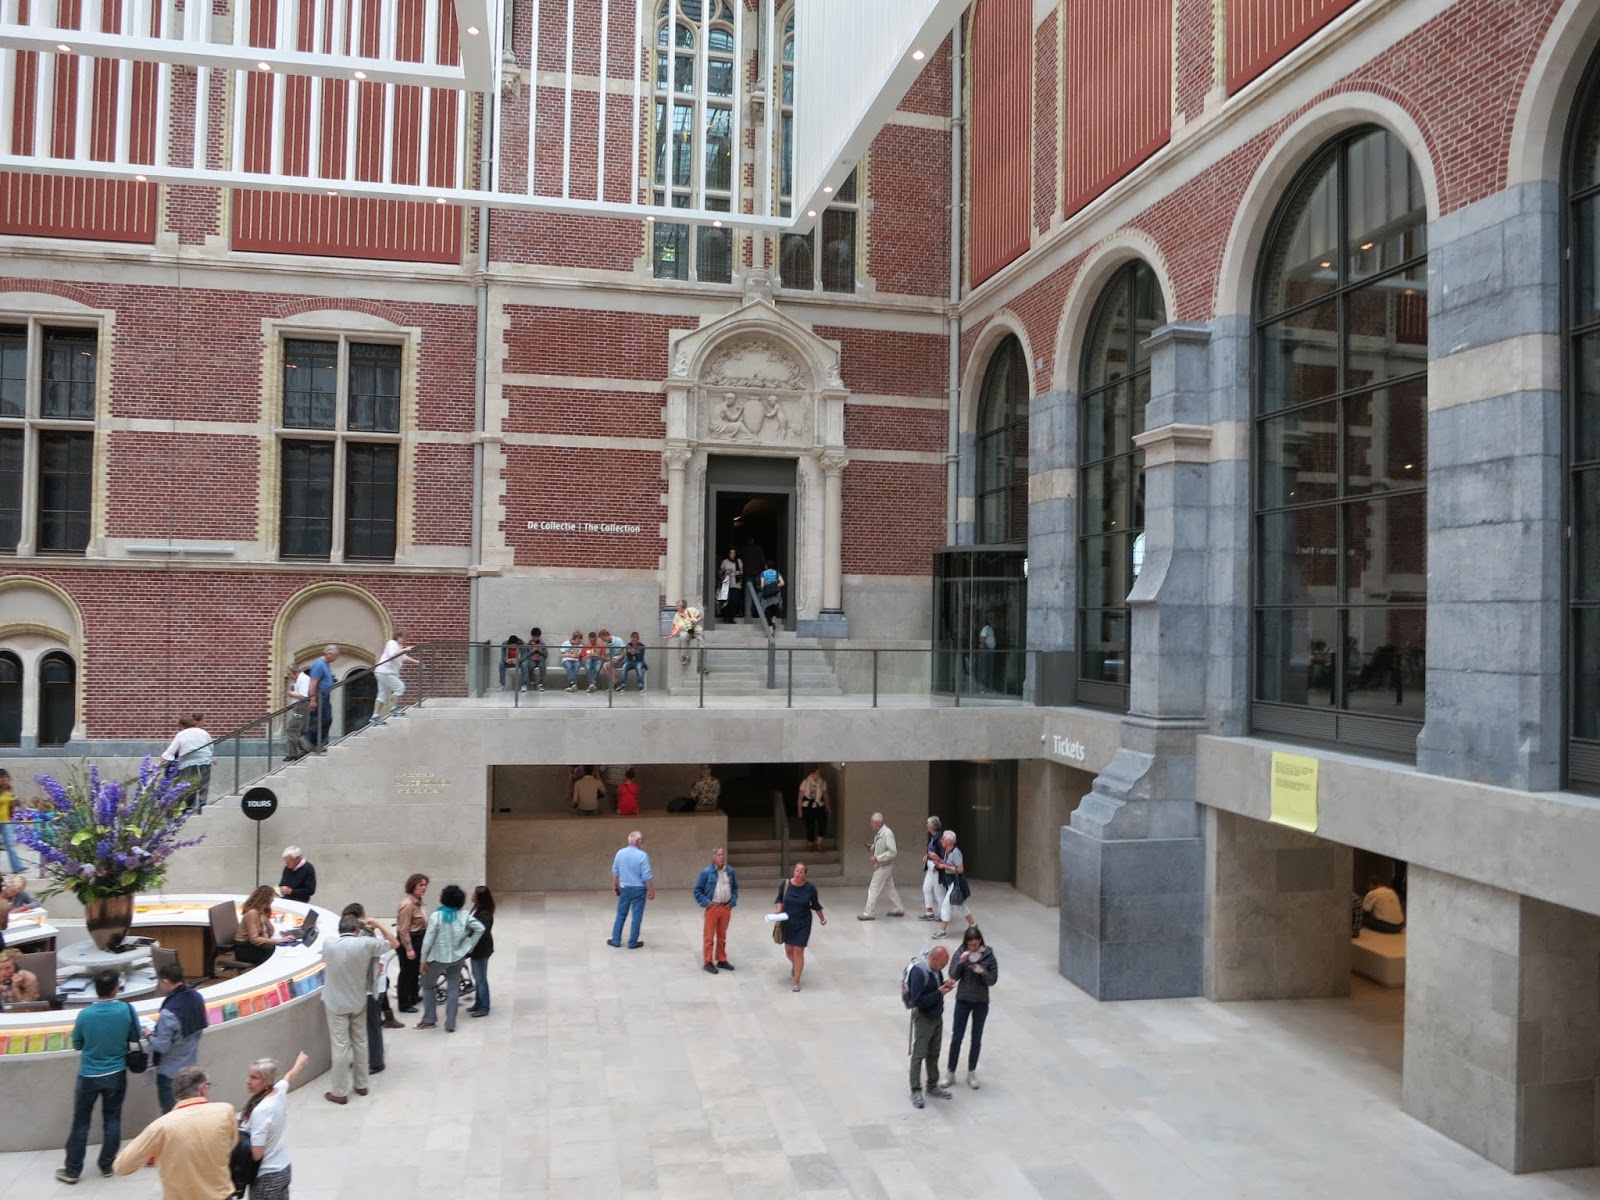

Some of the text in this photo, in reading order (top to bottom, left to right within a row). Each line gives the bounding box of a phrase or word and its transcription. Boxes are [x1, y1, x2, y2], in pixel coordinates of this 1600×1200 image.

[527, 521, 641, 533] De Collectie The Collection
[1053, 735, 1085, 761] Tickets
